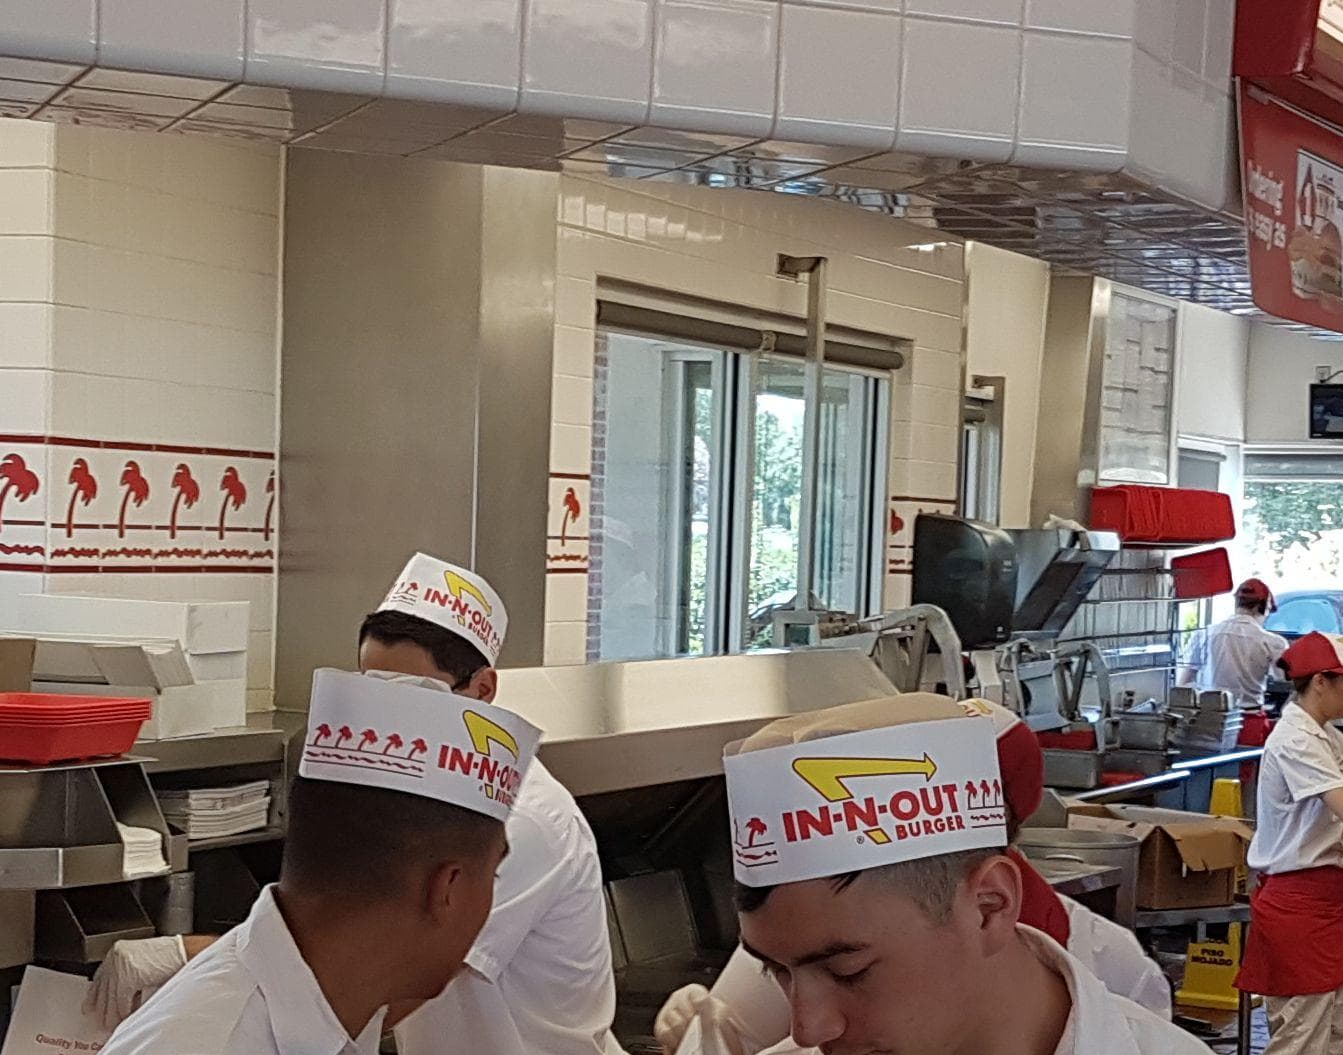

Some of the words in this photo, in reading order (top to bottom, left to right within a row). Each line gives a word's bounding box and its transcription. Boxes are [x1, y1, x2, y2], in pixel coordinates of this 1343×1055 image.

[424, 588, 493, 637] IN-N-OUT
[782, 784, 959, 842] IN-N-OUT
[895, 815, 966, 841] BURGER
[35, 1033, 71, 1049] Quality
[74, 1040, 90, 1050] You
[91, 1042, 105, 1051] Ca
